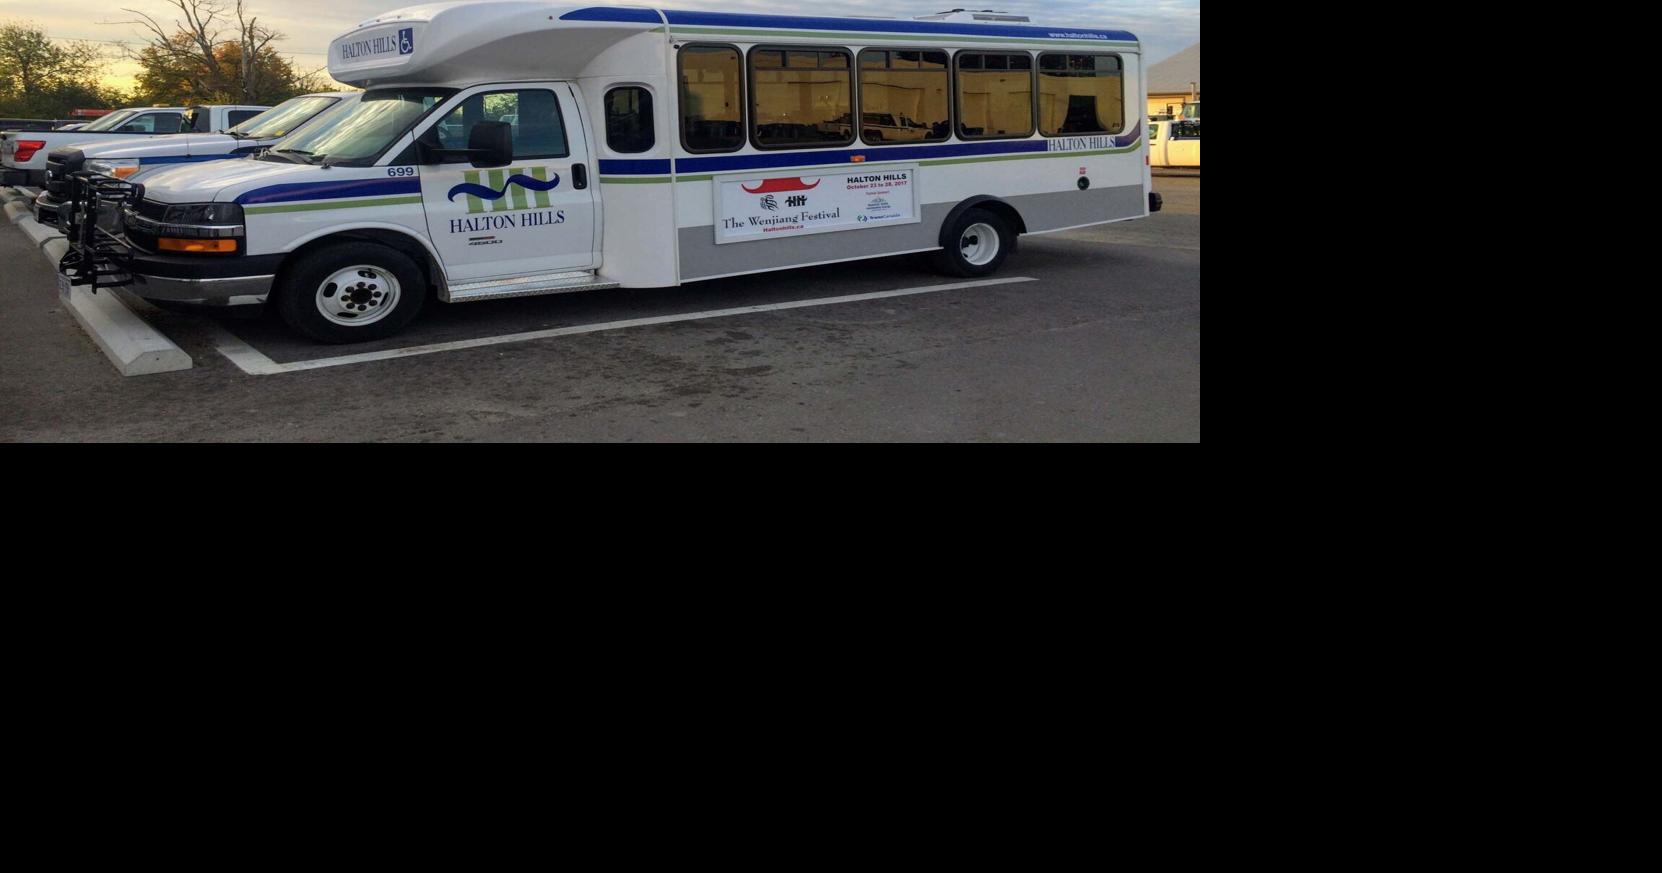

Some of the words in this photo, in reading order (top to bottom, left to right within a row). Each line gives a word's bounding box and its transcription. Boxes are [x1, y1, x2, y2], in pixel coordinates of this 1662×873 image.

[342, 40, 371, 59] HALTON
[373, 36, 396, 54] HILLS
[1048, 138, 1085, 151] HALTON
[1089, 136, 1115, 149] HILLS
[387, 166, 414, 177] 699
[847, 175, 881, 184] HALTON
[883, 173, 907, 181] HILLS
[449, 214, 516, 233] HALTON
[521, 210, 565, 227] HILLS
[722, 217, 745, 229] The
[748, 215, 798, 226] Wenjiang
[801, 207, 840, 221] Festival
